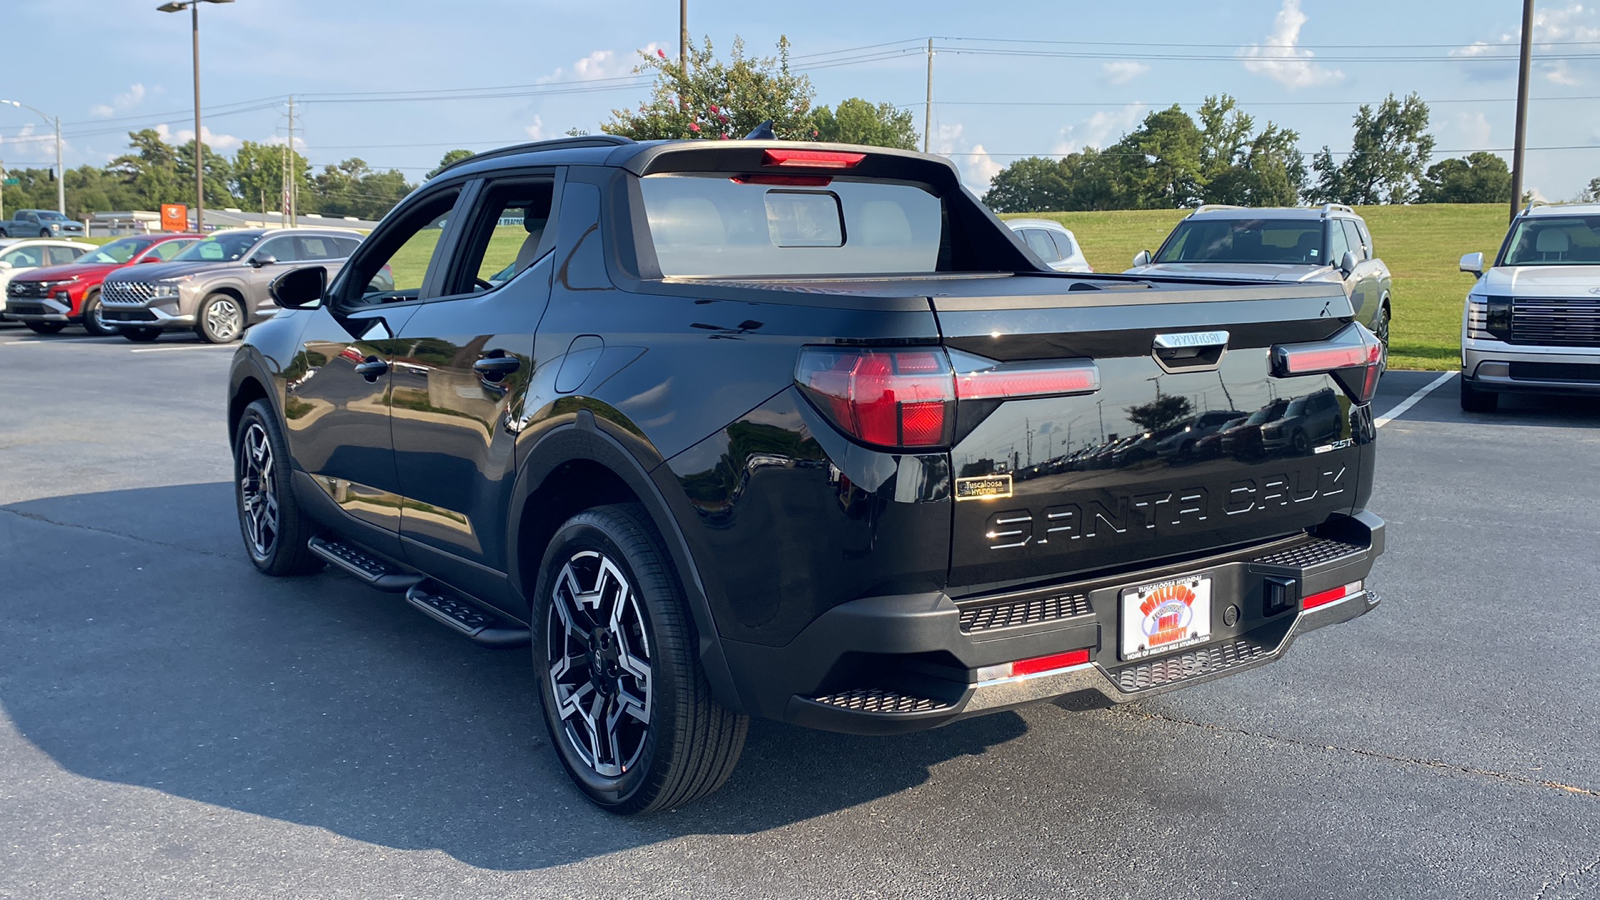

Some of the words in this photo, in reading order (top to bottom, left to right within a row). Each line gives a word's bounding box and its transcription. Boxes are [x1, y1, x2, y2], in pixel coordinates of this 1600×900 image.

[504, 218, 524, 226] TRACTO
[1171, 333, 1220, 346] HYUNDAI
[965, 480, 1003, 489] Tuscaloosa
[971, 487, 997, 496] HYUNDAI
[985, 486, 1209, 550] SANTA
[1222, 461, 1347, 515] CRUZ
[1139, 585, 1196, 617] MILLION
[1158, 612, 1179, 632] MILE
